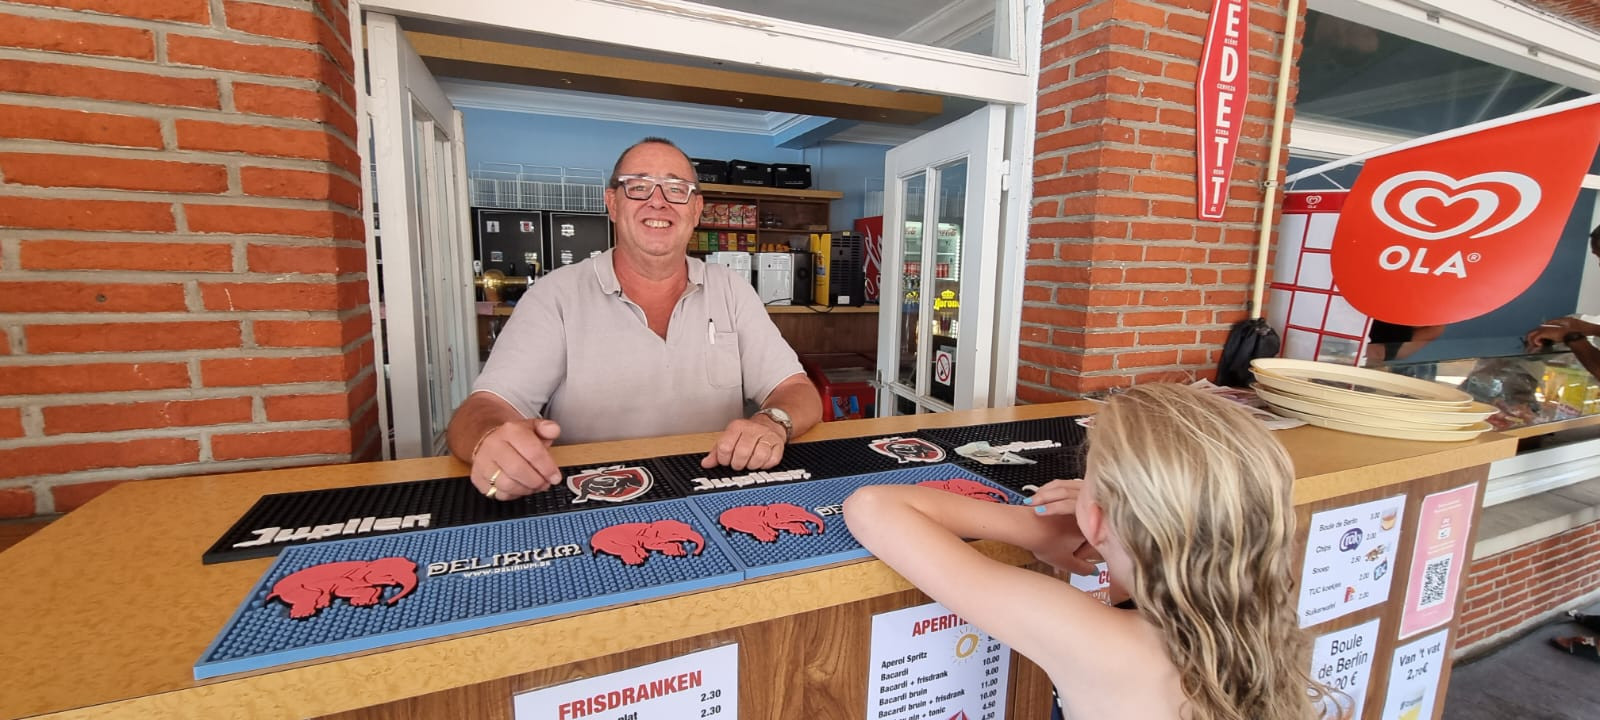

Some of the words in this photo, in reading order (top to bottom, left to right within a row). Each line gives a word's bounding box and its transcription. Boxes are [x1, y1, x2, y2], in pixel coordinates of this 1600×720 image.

[233, 513, 431, 548] Jupiler
[427, 543, 583, 577] DELIRIUM
[1330, 633, 1363, 656] Boule
[1400, 652, 1416, 667] Van
[1427, 642, 1441, 655] vat
[881, 659, 905, 669] Aperol
[907, 652, 927, 663] Spritz
[1318, 664, 1333, 680] de
[1336, 652, 1368, 673] Berlin
[880, 668, 909, 681] Bacardi
[880, 680, 907, 694] Bacardi
[916, 671, 948, 684] frisdrank
[558, 670, 702, 720] FRISDRANKEN
[701, 689, 721, 702] 2.30
[878, 705, 906, 719] Bacardi
[908, 700, 927, 711] bruin
[935, 689, 965, 703] frisdrank
[879, 693, 907, 706] Bacardi
[909, 688, 927, 699] bruin
[701, 705, 721, 718] 2.30
[928, 706, 946, 717] tonic
